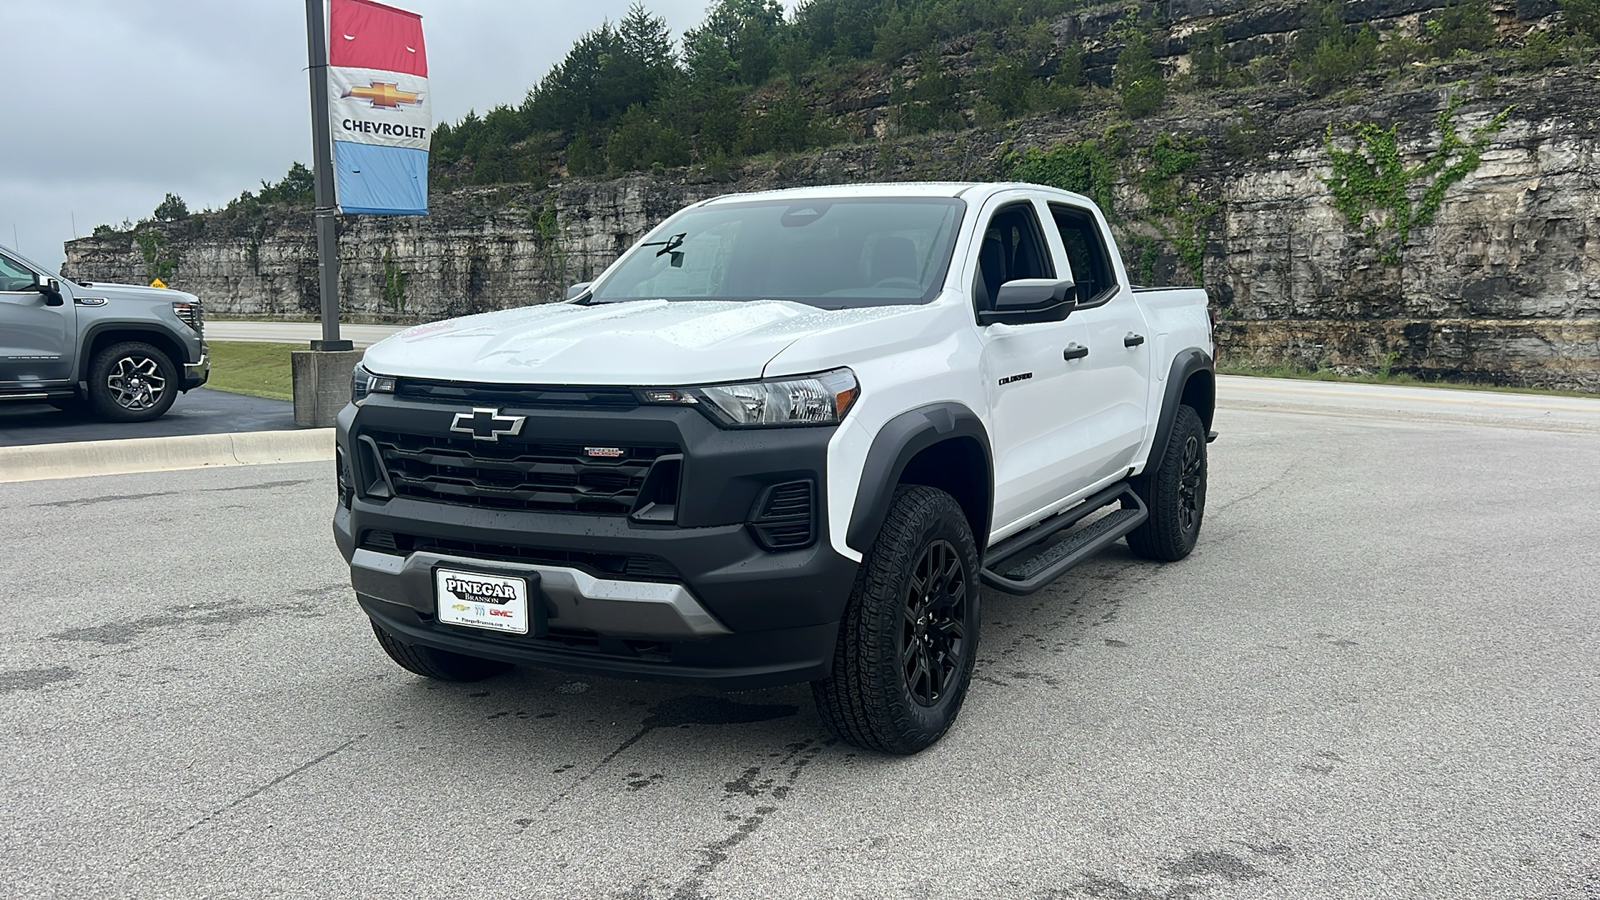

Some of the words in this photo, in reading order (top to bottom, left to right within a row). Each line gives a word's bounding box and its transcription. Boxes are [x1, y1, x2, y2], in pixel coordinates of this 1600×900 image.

[342, 118, 426, 140] CHEVROLET
[998, 371, 1033, 386] COLORADO
[446, 578, 517, 600] PINEGAR
[464, 593, 500, 604] BRANSON
[489, 608, 513, 618] GMC
